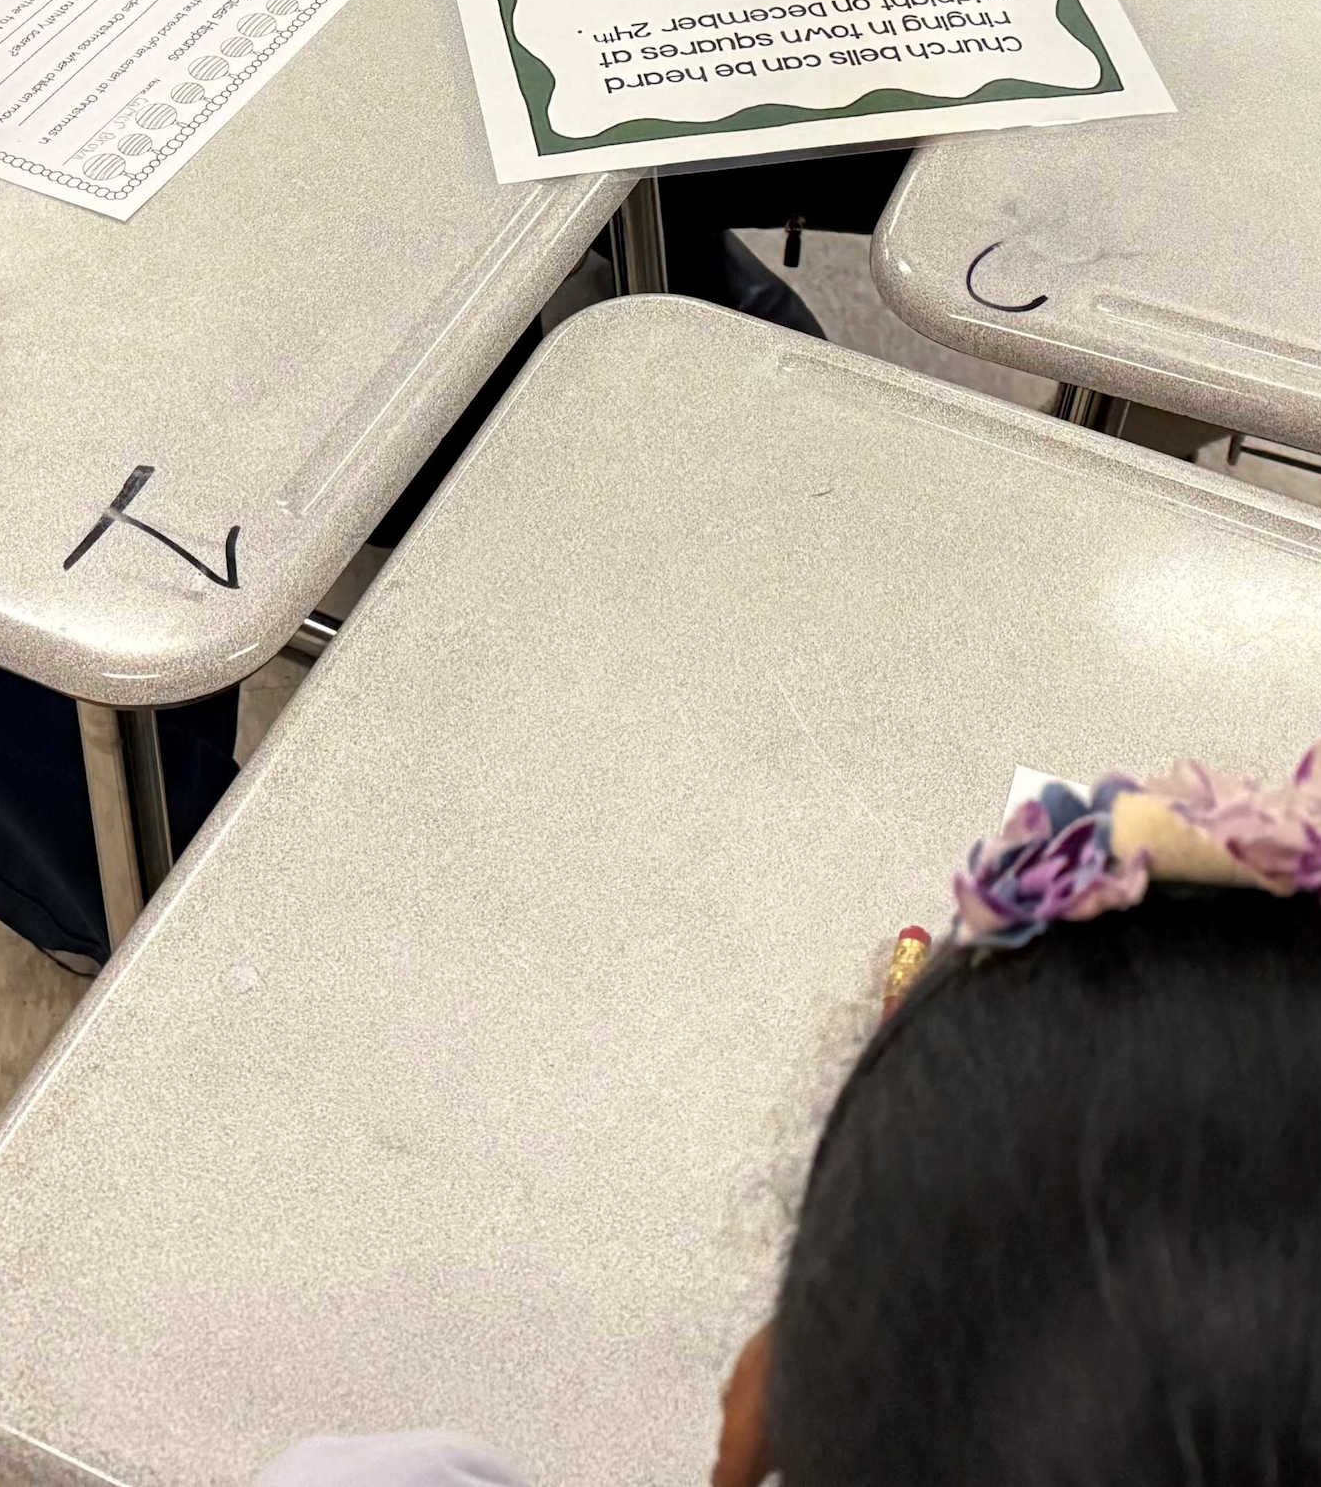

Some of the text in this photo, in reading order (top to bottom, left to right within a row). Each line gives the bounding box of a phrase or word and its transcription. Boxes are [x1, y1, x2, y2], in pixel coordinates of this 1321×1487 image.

[36, 0, 75, 29] nativity
[156, 11, 188, 37] bread
[660, 1, 828, 32] December
[7, 28, 41, 57] scene?
[76, 12, 125, 51] Christmas
[131, 35, 160, 58] often
[166, 19, 219, 61] Hispanos
[592, 21, 652, 44] 24th
[598, 10, 1011, 68] ringing in town squares at
[53, 51, 80, 72] when
[106, 57, 134, 82] eaten
[603, 35, 1022, 94] Church bells can be heard
[17, 71, 56, 103] children
[47, 93, 98, 136] Christmas
